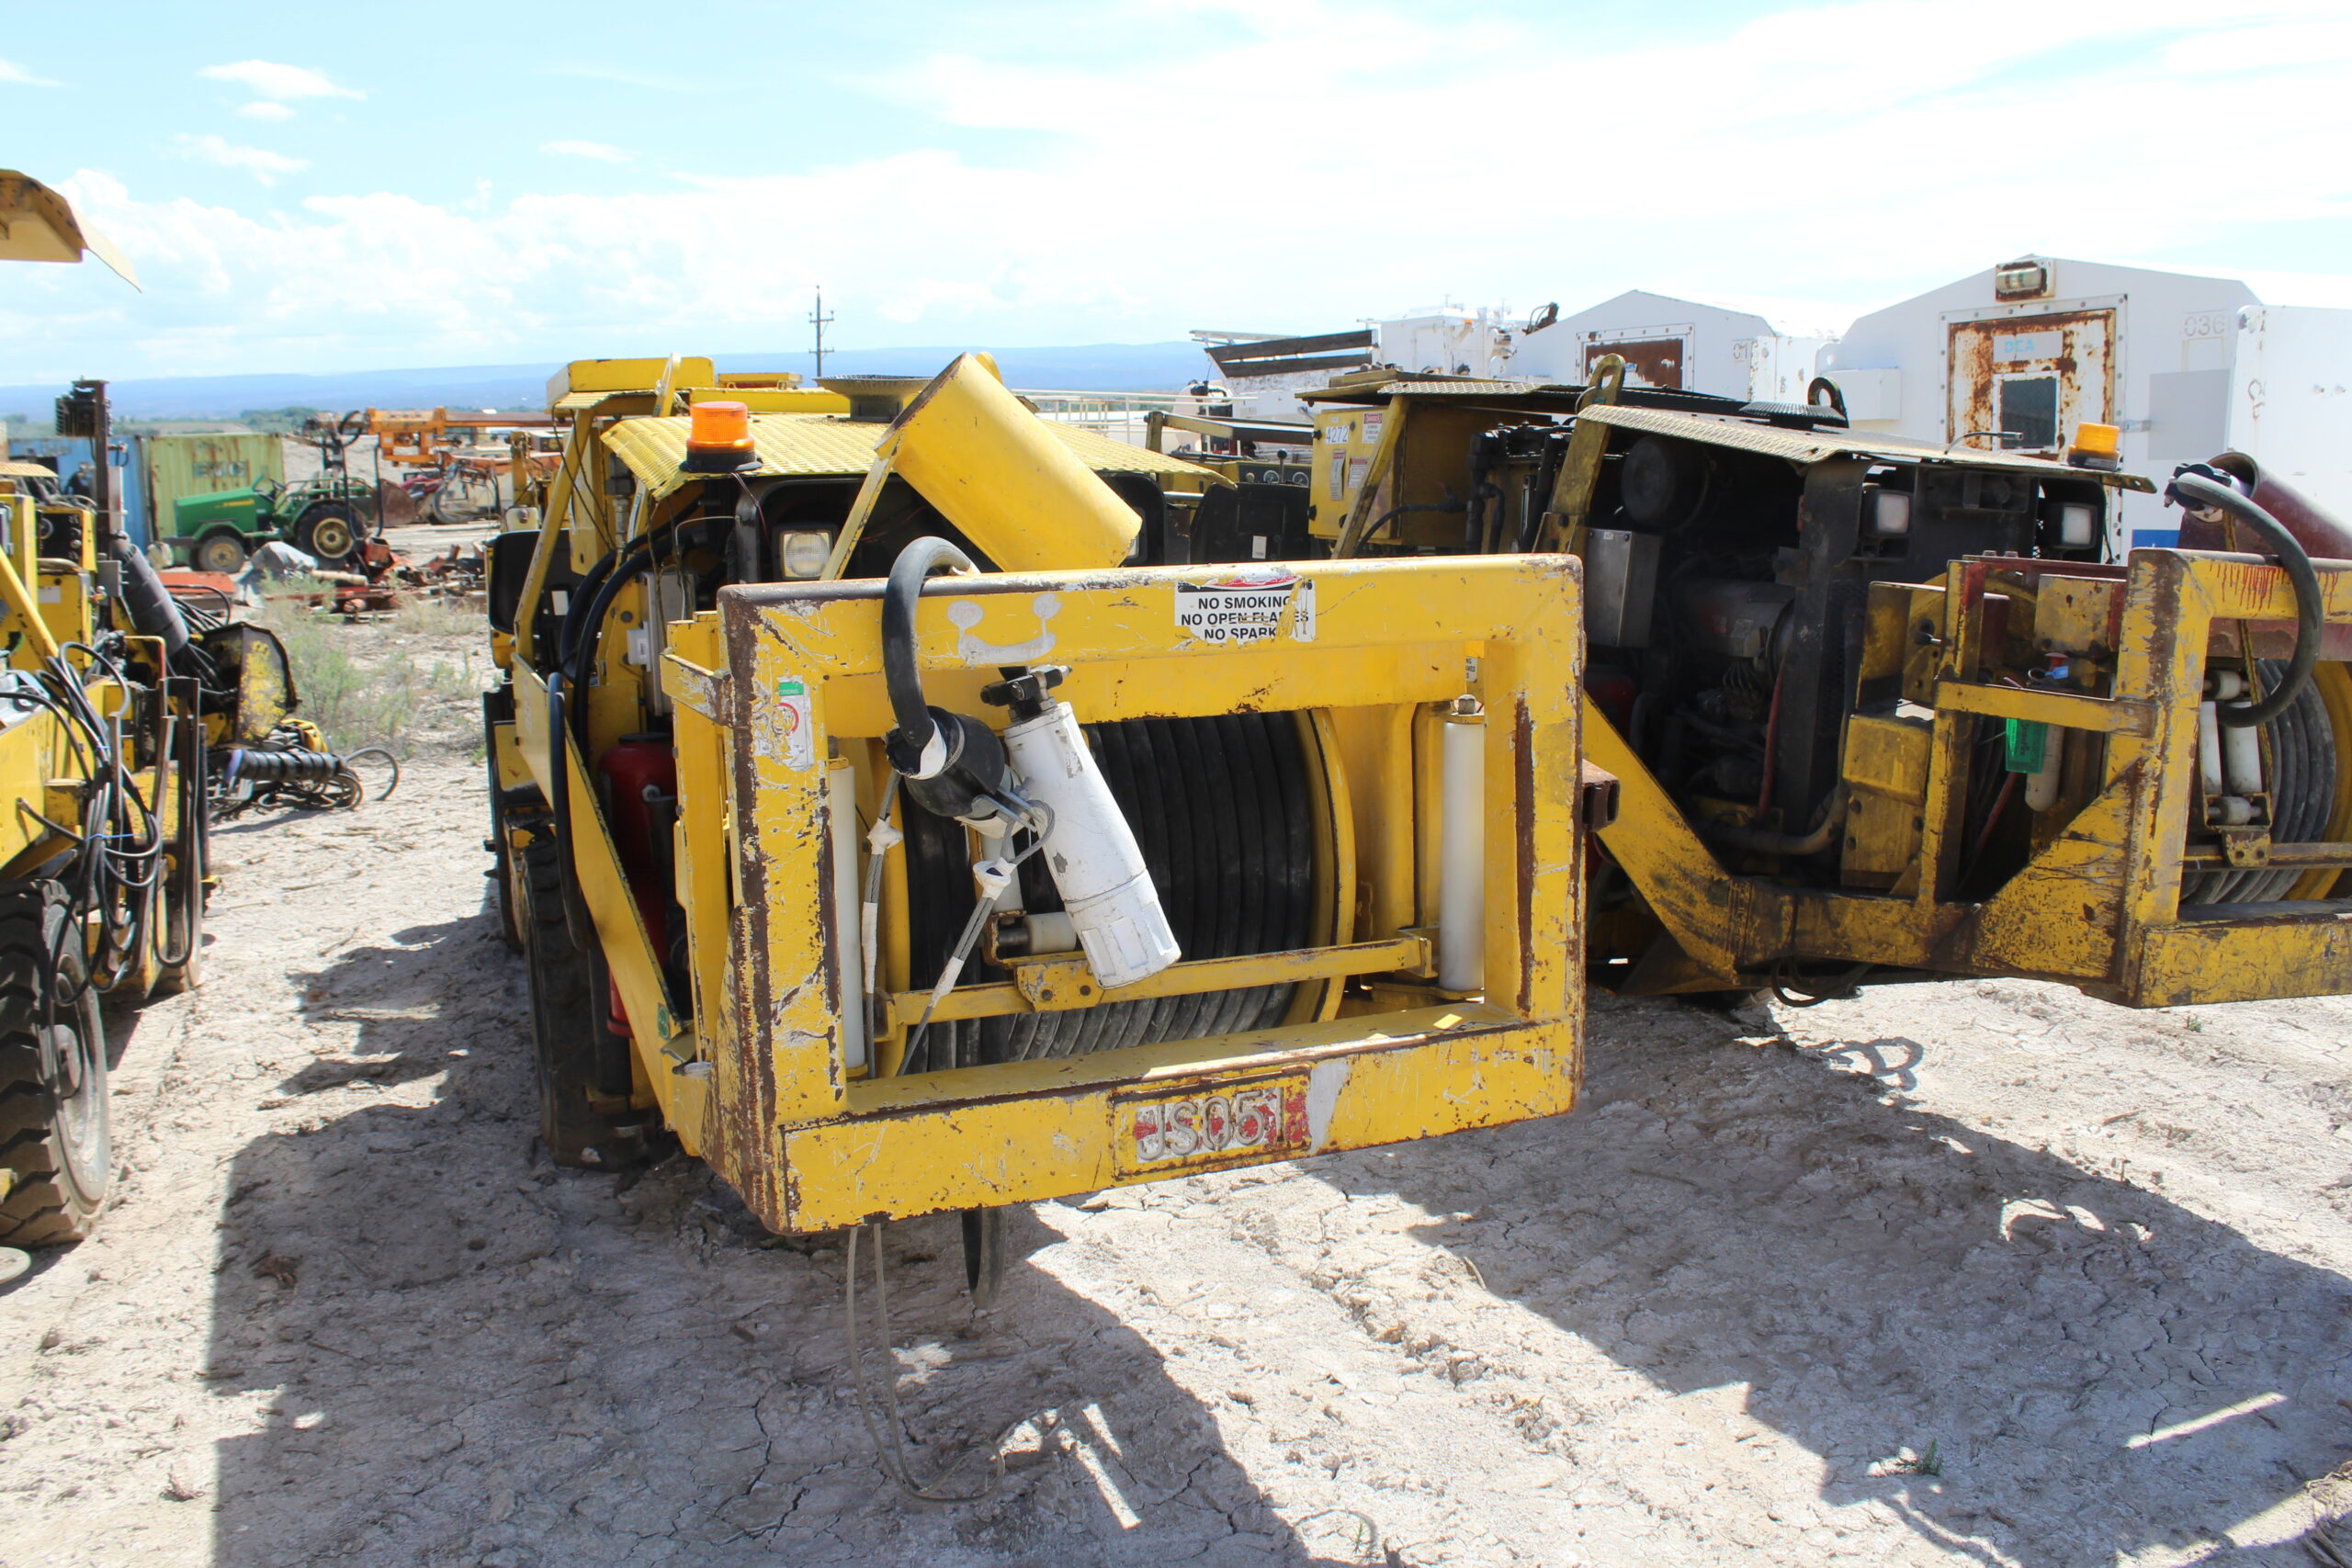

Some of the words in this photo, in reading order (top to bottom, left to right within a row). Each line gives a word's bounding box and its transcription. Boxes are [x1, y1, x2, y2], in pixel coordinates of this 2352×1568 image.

[1326, 426, 1349, 443] 4272
[1198, 597, 1220, 610] NO
[1181, 614, 1203, 626] NO
[1207, 613, 1248, 625] OPEN
[1252, 611, 1309, 624] FLAES
[1204, 628, 1226, 640] NO
